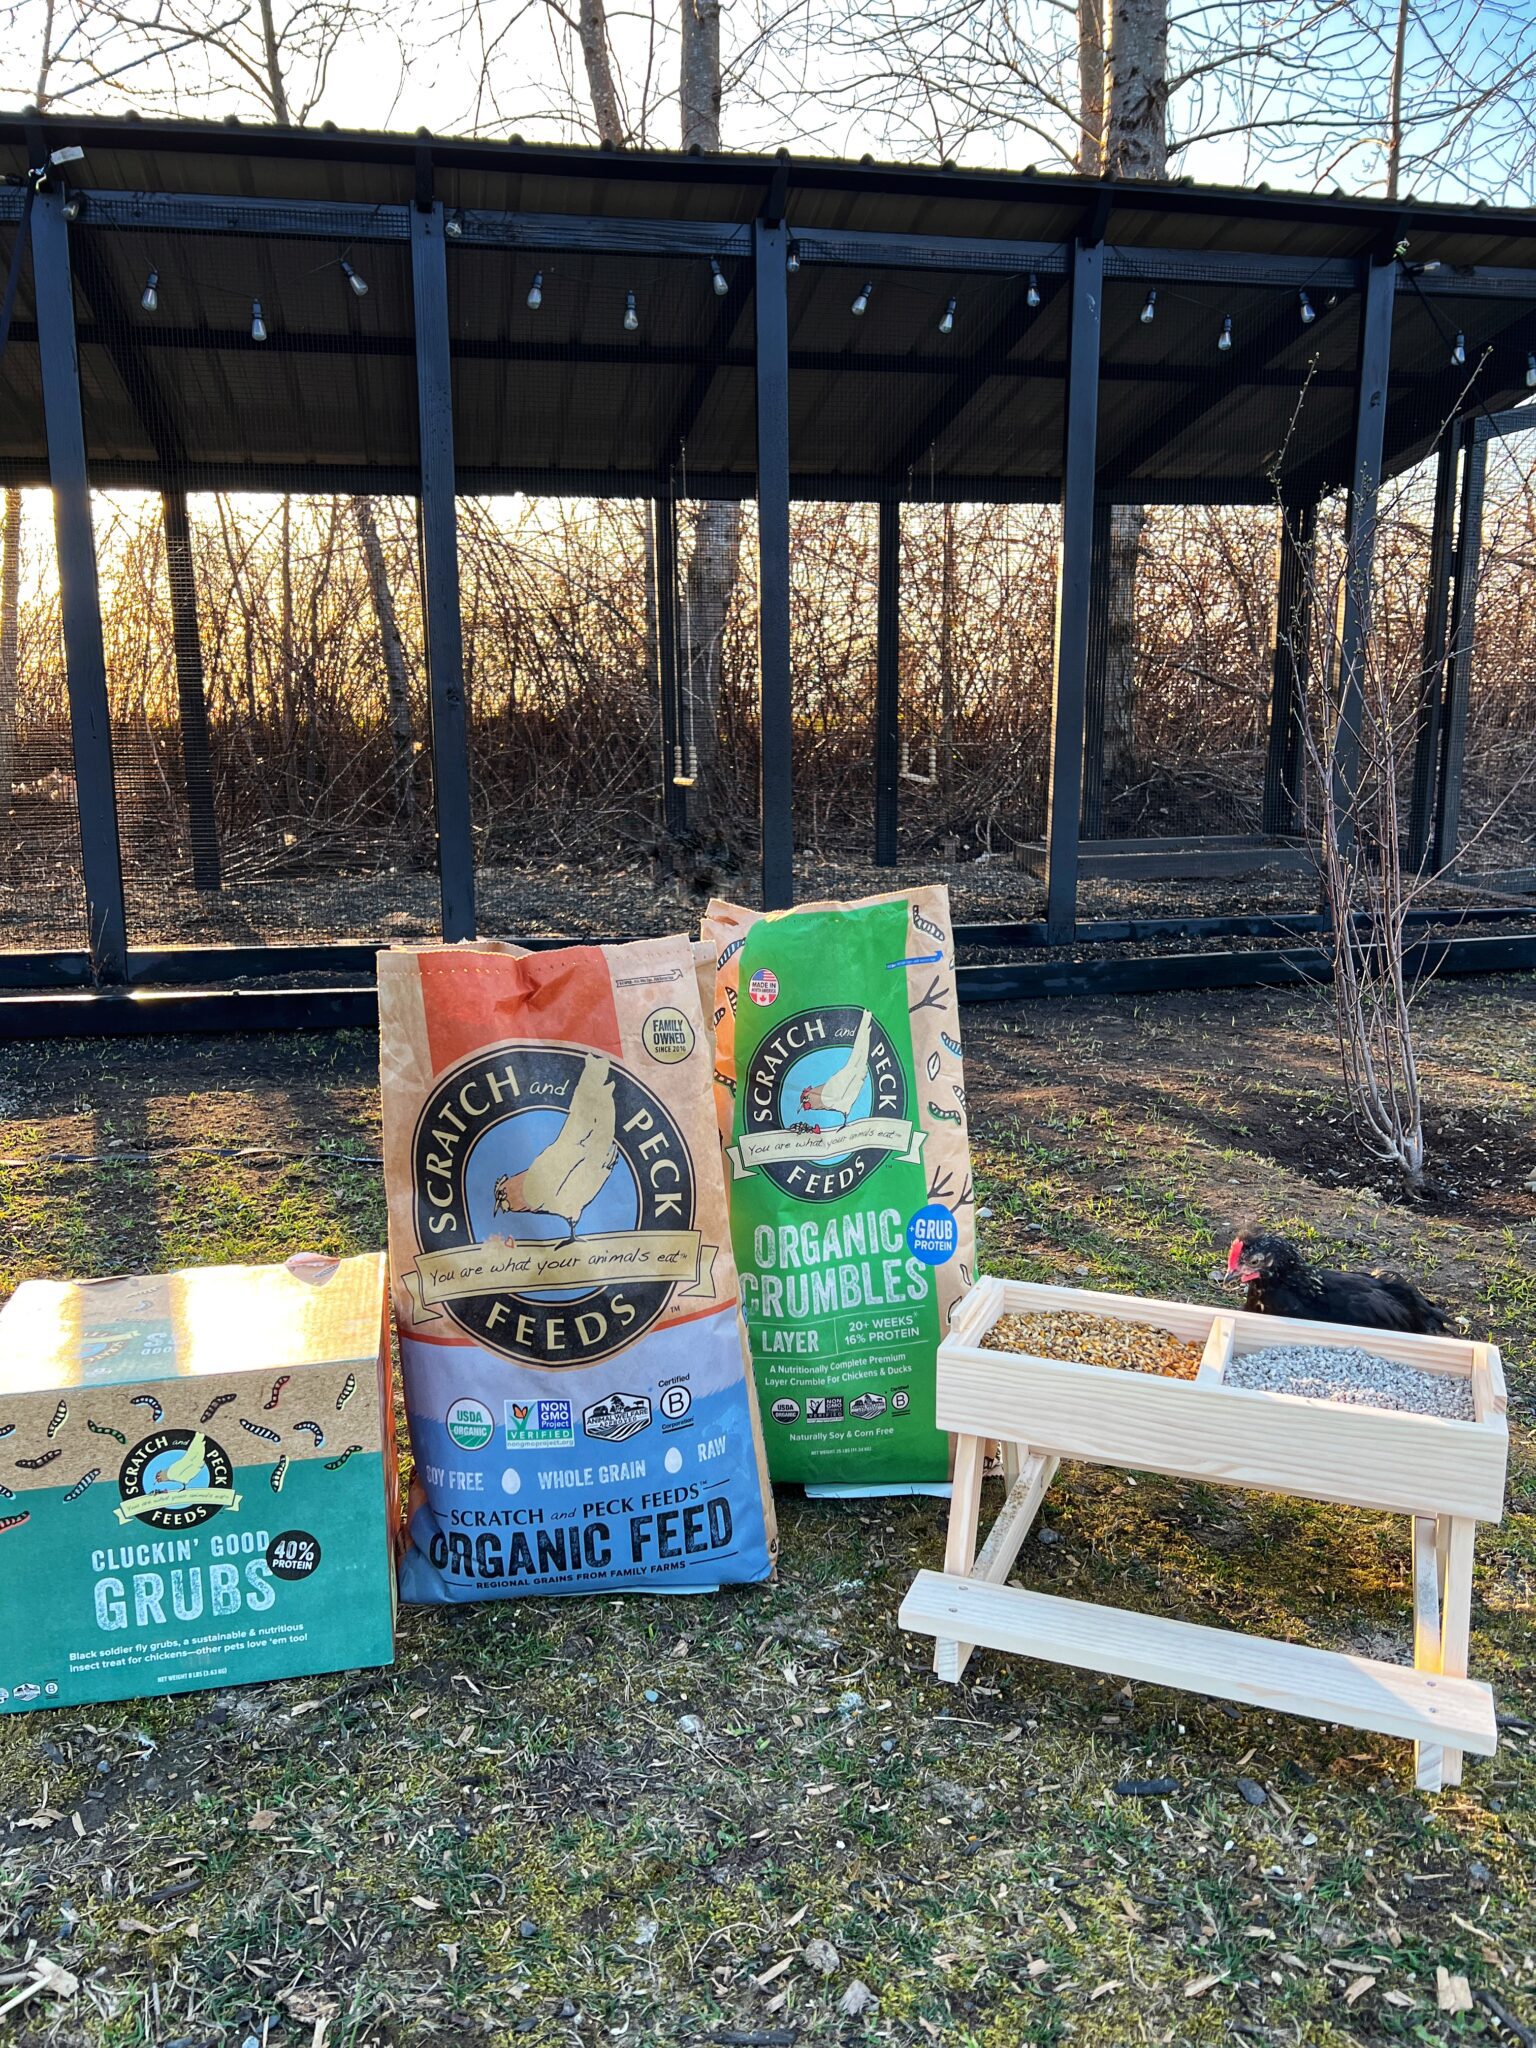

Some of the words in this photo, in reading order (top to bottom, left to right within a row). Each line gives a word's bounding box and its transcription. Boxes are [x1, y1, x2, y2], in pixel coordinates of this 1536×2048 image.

[653, 1019, 683, 1032] FAMILY
[653, 1032, 686, 1045] OWNED
[753, 1018, 826, 1122] SCRATCH
[834, 1025, 855, 1038] and
[869, 1042, 897, 1110] PECK
[427, 1066, 520, 1234] SCRATCH
[530, 1079, 569, 1097] and
[623, 1108, 682, 1218] PECK
[748, 1145, 770, 1156] You
[774, 1142, 791, 1150] are
[796, 1137, 823, 1148] what
[826, 1135, 847, 1149] your
[786, 1156, 865, 1194] FEEDS
[754, 1208, 903, 1271] ORGANIC
[914, 1240, 952, 1251] PROTEIN
[430, 1267, 455, 1287] You
[460, 1266, 483, 1278] are
[490, 1258, 531, 1274] what
[537, 1257, 581, 1275] your
[588, 1246, 649, 1266] animals
[739, 1256, 929, 1318] CRUMBLES
[485, 1294, 636, 1350] FEEDS
[848, 1320, 870, 1332] 20+
[762, 1330, 820, 1353] LAYER
[844, 1332, 866, 1346] 16%
[869, 1327, 920, 1343] PROTEIN
[770, 1365, 777, 1374] A
[778, 1364, 829, 1375] Nutritionally
[830, 1358, 868, 1371] Complete
[869, 1352, 906, 1364] Premium
[658, 1373, 690, 1388] Certified
[765, 1378, 788, 1388] Layer
[790, 1377, 826, 1386] Crumble
[827, 1375, 840, 1384] For
[842, 1369, 878, 1382] Chickens
[880, 1368, 886, 1376] &
[888, 1364, 912, 1375] Ducks
[541, 1402, 568, 1412] NON
[668, 1392, 685, 1414] B
[896, 1394, 906, 1407] B
[457, 1410, 483, 1423] USDA
[541, 1411, 569, 1420] GMO
[541, 1420, 570, 1429] Project
[587, 1414, 614, 1426] ANIMAL
[615, 1407, 648, 1421] WELFARE
[600, 1416, 638, 1428] APPROVED
[662, 1418, 694, 1430] Corporation
[453, 1425, 488, 1437] ORGANIC
[511, 1430, 570, 1440] VERIFIED
[789, 1432, 828, 1442] Naturally
[829, 1431, 845, 1440] Soy
[846, 1430, 852, 1438] &
[854, 1428, 874, 1438] Corn
[876, 1426, 894, 1436] Free
[507, 1440, 574, 1448] nongmoproject.org
[697, 1435, 726, 1462] RAW
[124, 1436, 168, 1495] SCRATCH
[206, 1449, 228, 1485] PECK
[538, 1468, 594, 1490] WHOLE
[598, 1459, 646, 1484] GRAIN
[426, 1464, 445, 1487] SOY
[449, 1471, 484, 1491] FREE
[152, 1506, 207, 1525] FEEDS
[451, 1508, 544, 1527] SCRATCH
[550, 1507, 577, 1520] and
[583, 1497, 634, 1518] PECK
[210, 1530, 270, 1558] GOOD
[430, 1522, 612, 1579] ORGANIC
[630, 1496, 732, 1563] FEED
[274, 1540, 314, 1561] 40%
[272, 1559, 313, 1570] PROTEIN
[476, 1578, 530, 1590] REGIONAL
[533, 1574, 574, 1585] GRAINS
[576, 1571, 607, 1580] FROM
[610, 1566, 648, 1578] FAMILY
[651, 1560, 686, 1574] FARMS
[94, 1558, 276, 1631] GRUBS
[69, 1648, 98, 1662] Black
[100, 1645, 134, 1658] soldier
[136, 1642, 148, 1654] fly
[150, 1637, 182, 1652] grubs,
[184, 1638, 190, 1646] a
[192, 1628, 247, 1644] sustainable
[248, 1628, 256, 1637] &
[258, 1622, 304, 1636] nutritious
[69, 1660, 100, 1673] insect
[102, 1656, 126, 1669] treat
[128, 1654, 142, 1665] for
[224, 1642, 245, 1654] pets
[247, 1638, 268, 1648] love
[290, 1632, 308, 1643] too!
